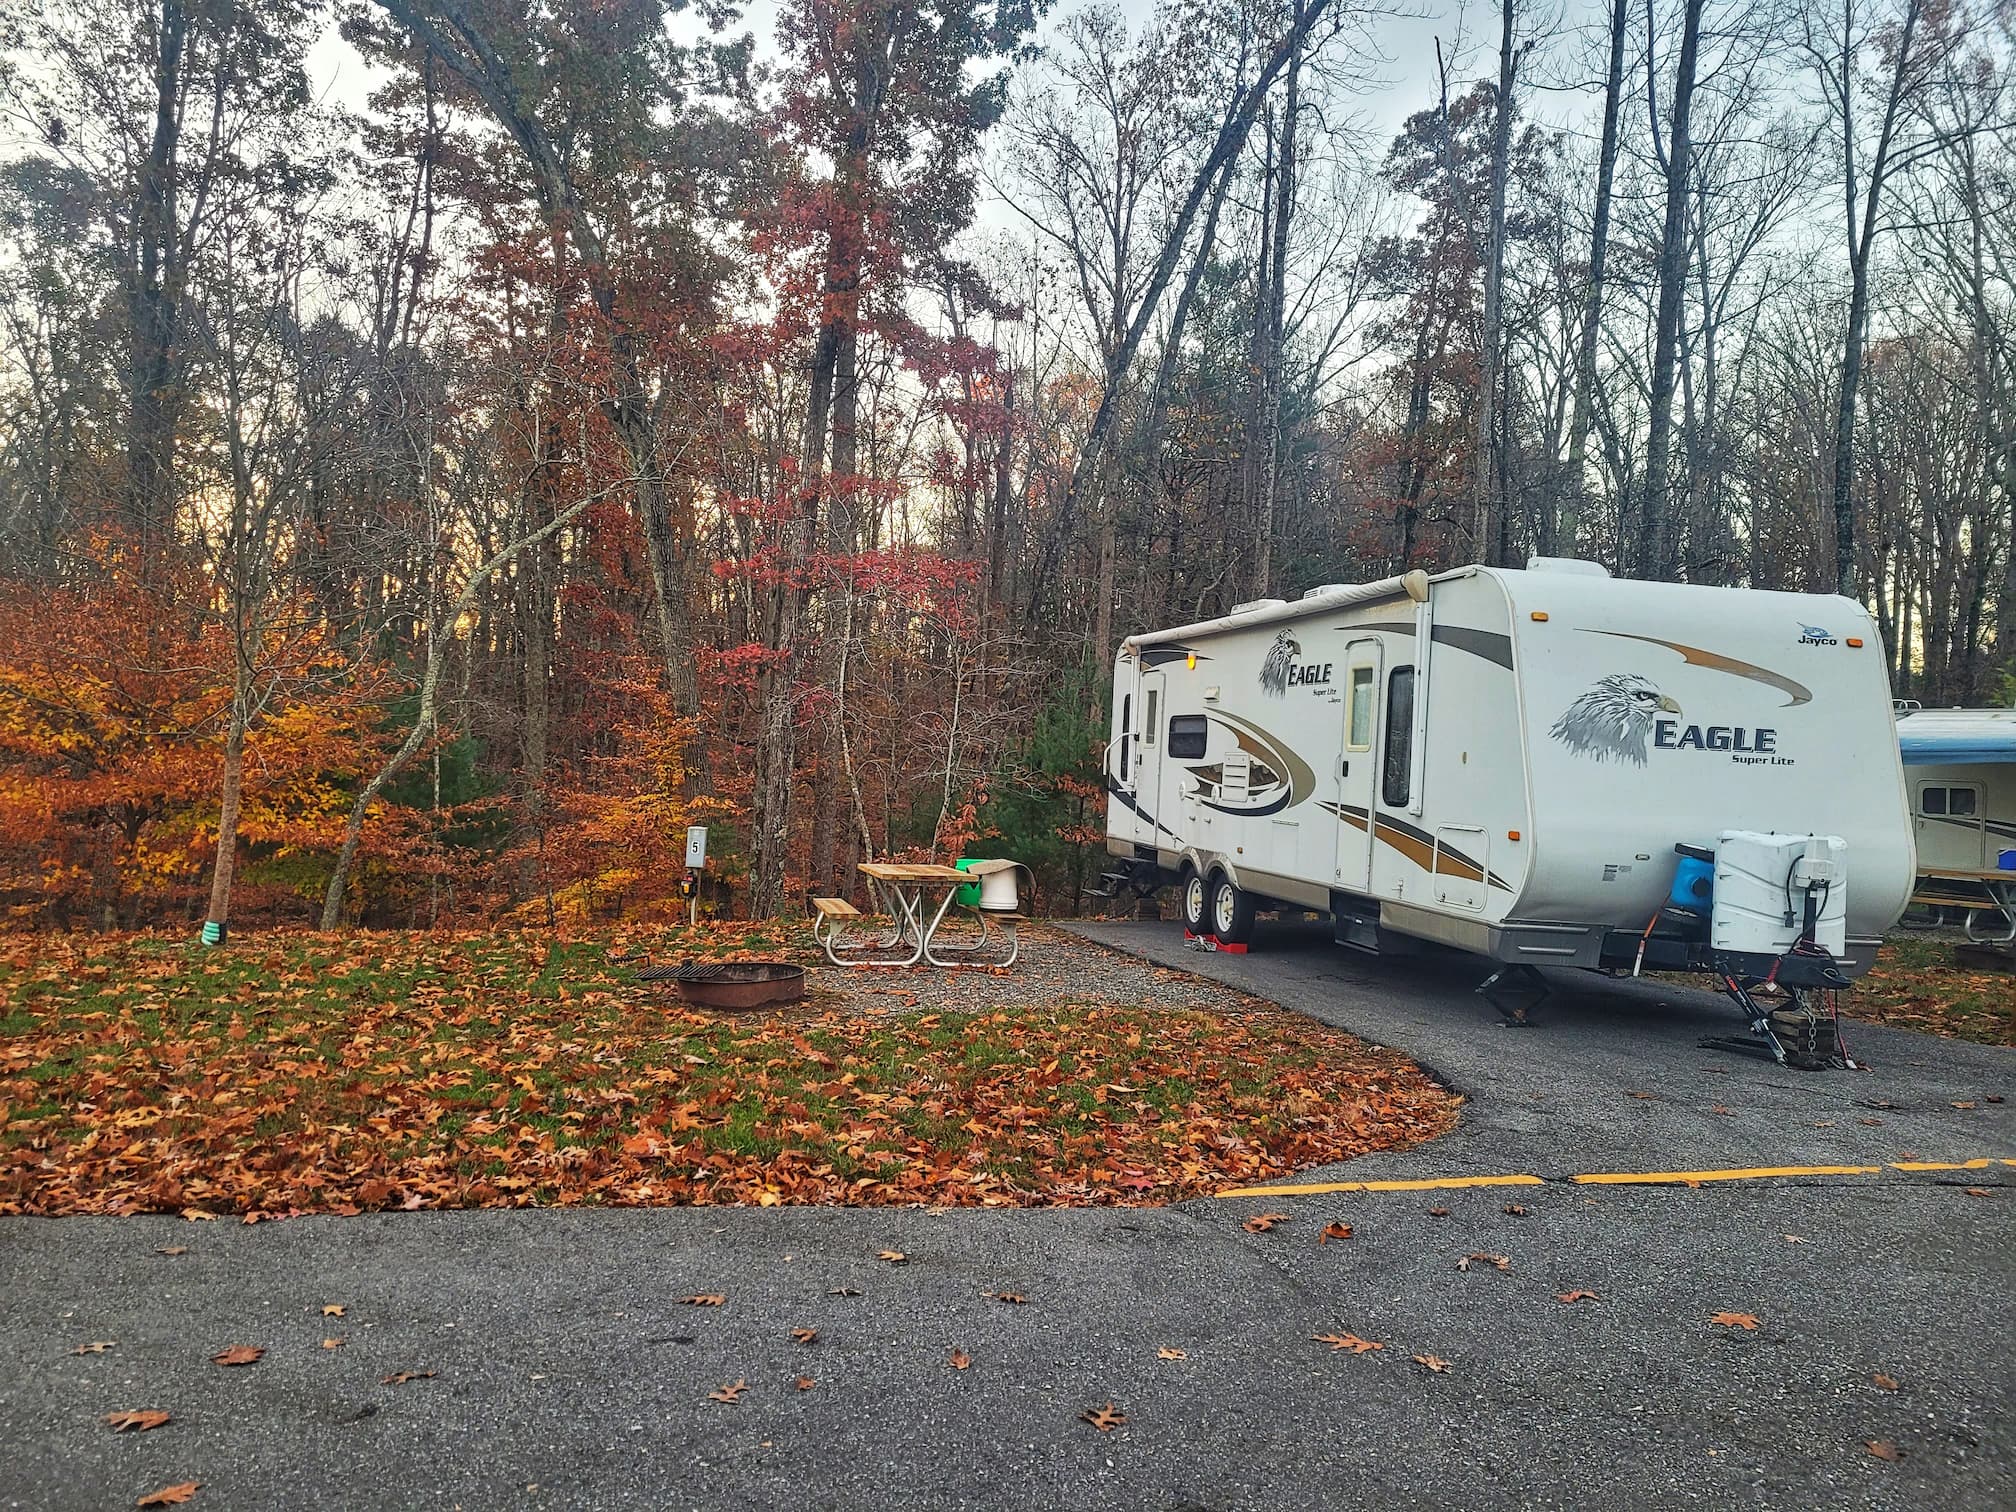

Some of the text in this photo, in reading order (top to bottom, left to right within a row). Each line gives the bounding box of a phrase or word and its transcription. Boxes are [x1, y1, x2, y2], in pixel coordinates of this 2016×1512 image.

[1798, 635, 1837, 647] Jayco
[1288, 664, 1332, 686] EAGLE
[1654, 719, 1777, 754] EAGLE
[1732, 755, 1795, 766] Super Lite
